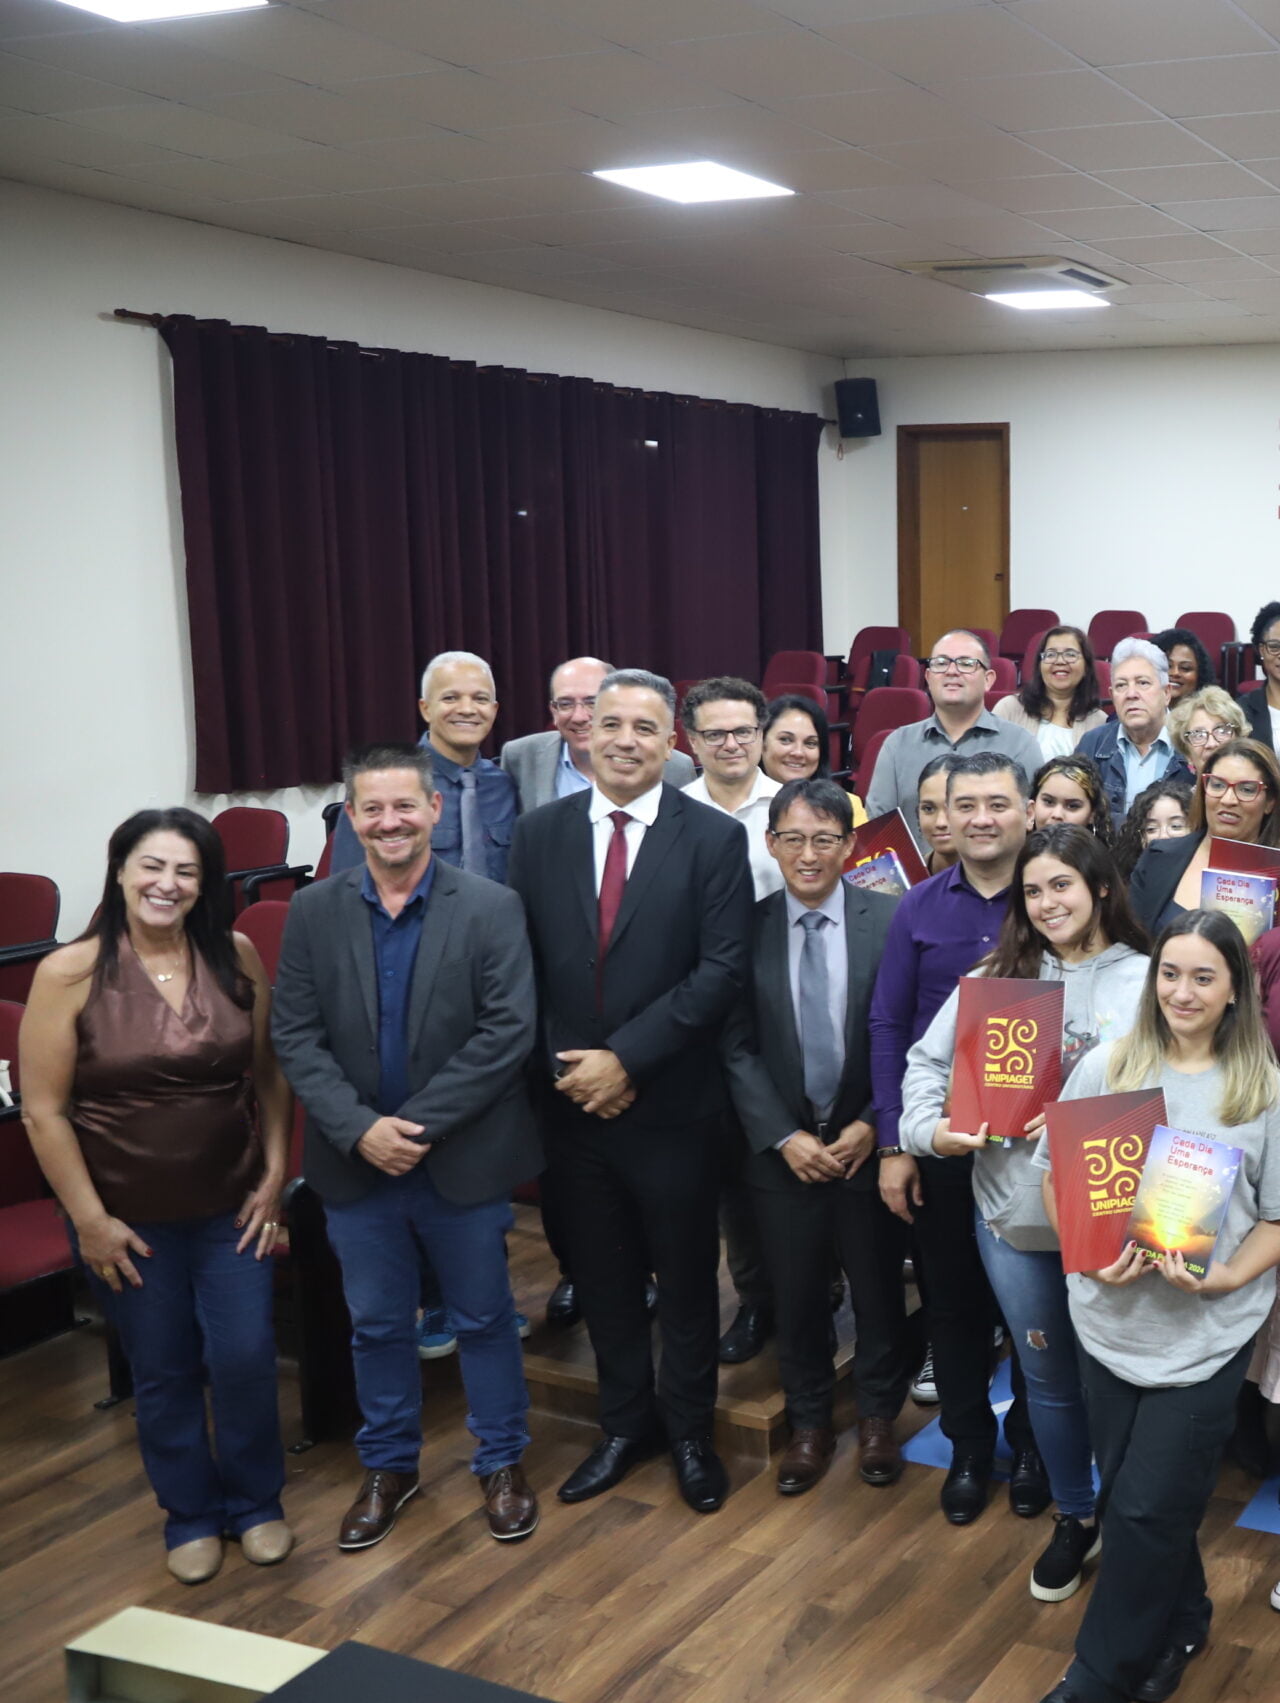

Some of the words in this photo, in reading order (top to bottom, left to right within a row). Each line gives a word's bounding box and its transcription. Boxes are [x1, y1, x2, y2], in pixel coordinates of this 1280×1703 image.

[1216, 877, 1236, 887] Cada
[1237, 879, 1250, 889] Dia
[1216, 885, 1233, 894] Uma
[1216, 893, 1254, 906] Esperança
[984, 1073, 1034, 1084] UNIPIAGET
[1172, 1136, 1196, 1150] Cada
[1198, 1143, 1213, 1155] Dia
[1170, 1146, 1191, 1159] Uma
[1167, 1155, 1214, 1176] Esperança
[1091, 1196, 1136, 1211] UNIPIAG
[1188, 1262, 1205, 1274] 2024
